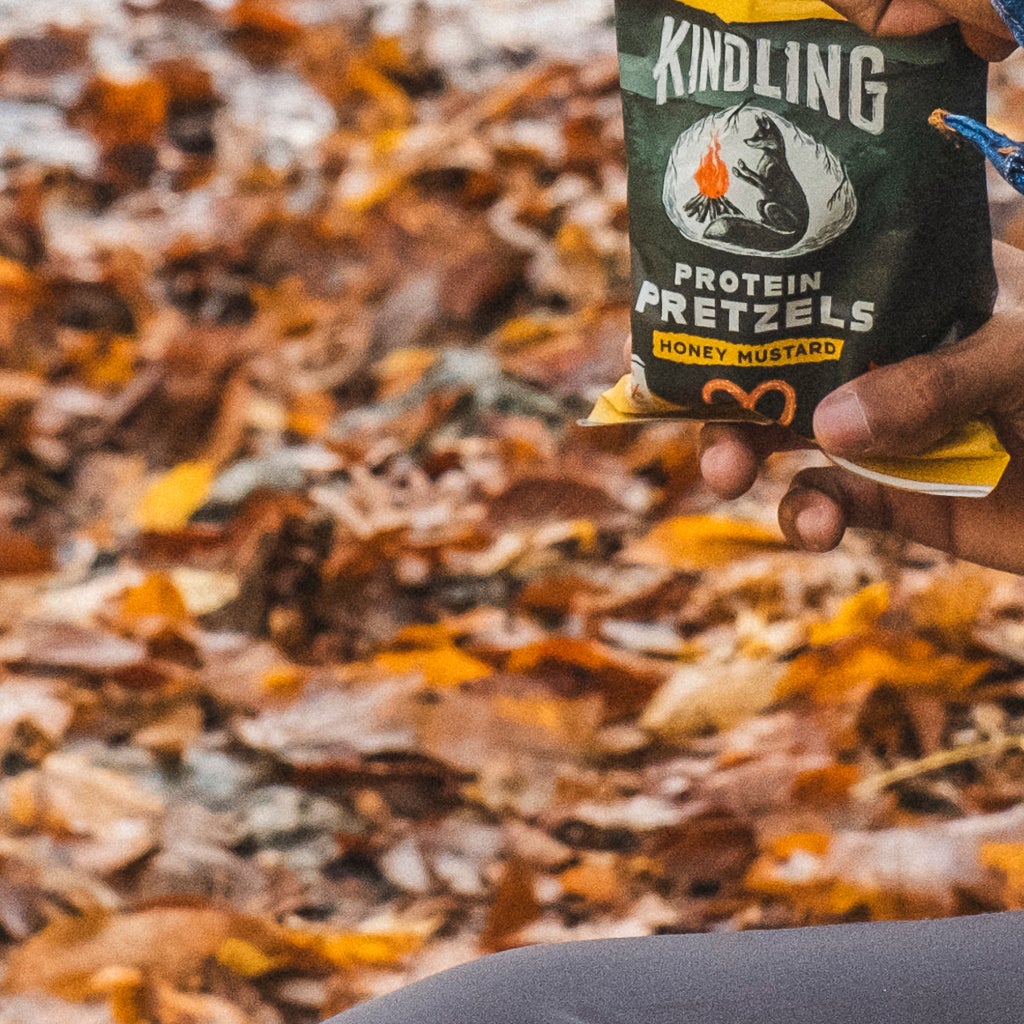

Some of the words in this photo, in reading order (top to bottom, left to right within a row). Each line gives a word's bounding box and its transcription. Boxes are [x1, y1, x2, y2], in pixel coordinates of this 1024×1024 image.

[652, 16, 888, 136] KINDLING
[674, 262, 822, 297] PROTEIN
[634, 280, 876, 334] PRETZELS
[659, 339, 728, 361] HONEY
[737, 341, 836, 364] MUSTARD
